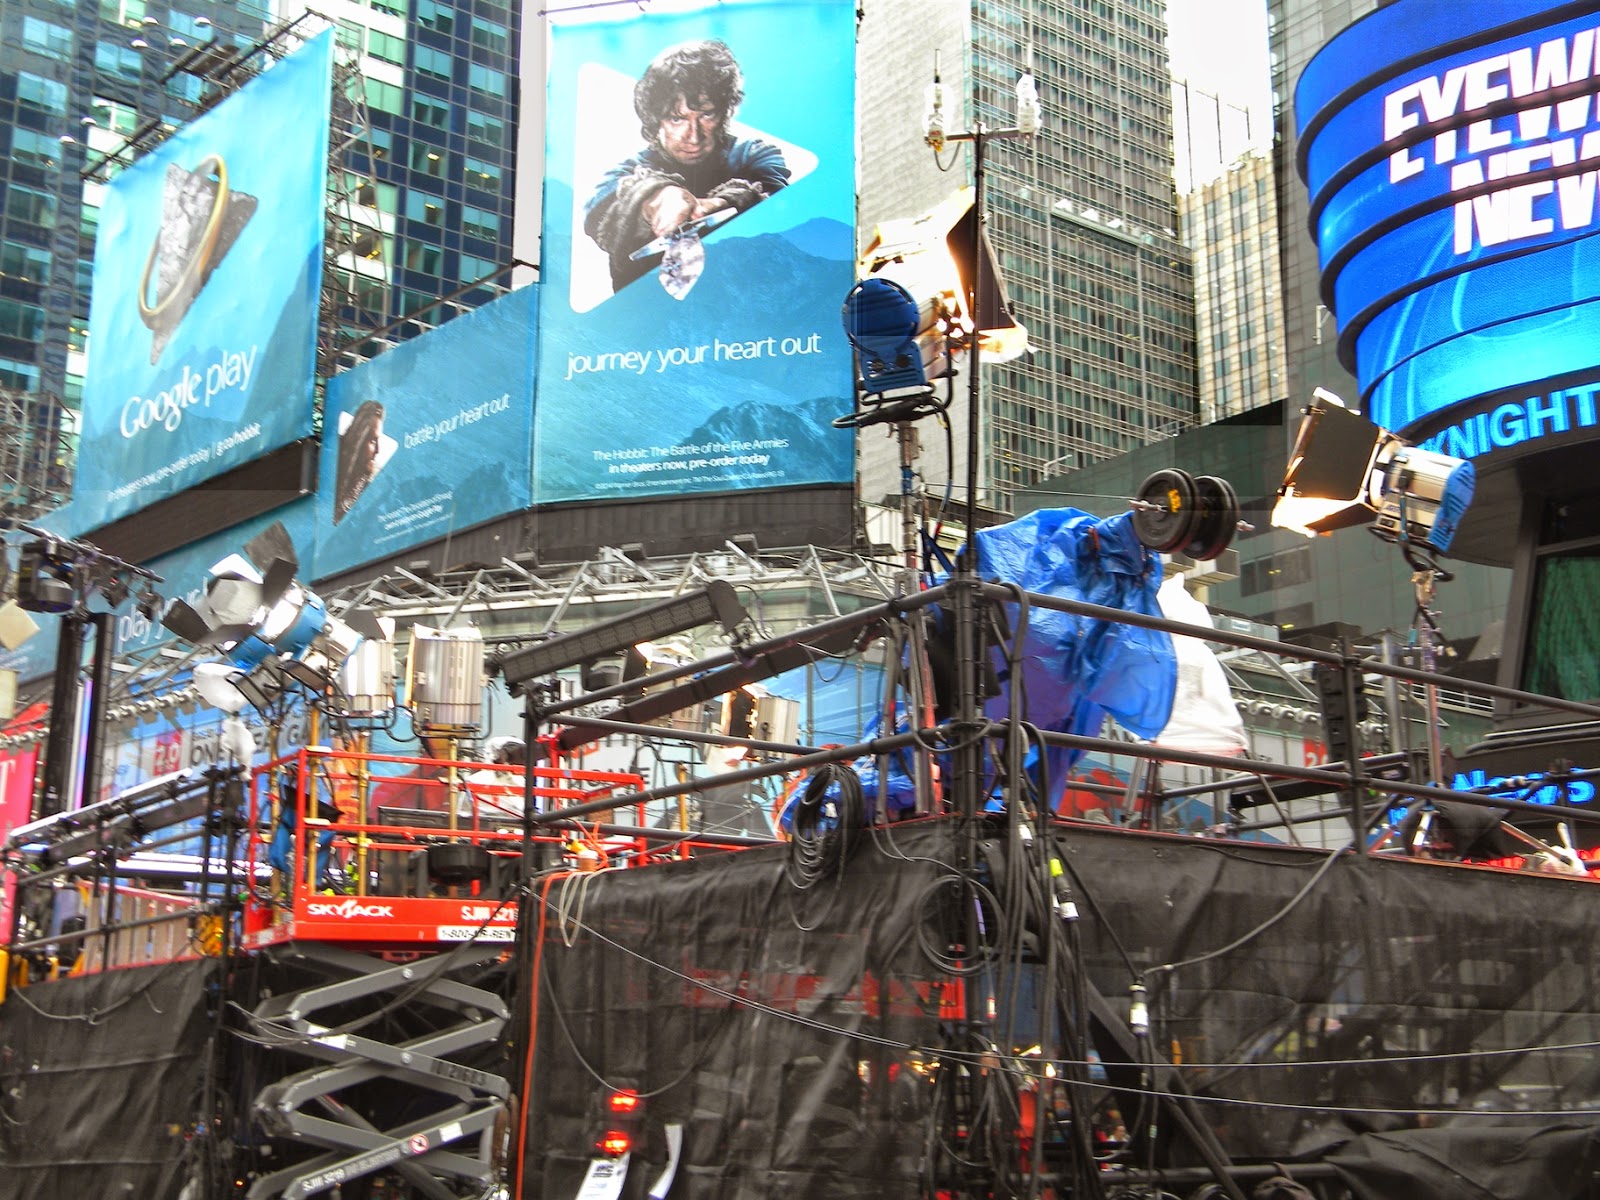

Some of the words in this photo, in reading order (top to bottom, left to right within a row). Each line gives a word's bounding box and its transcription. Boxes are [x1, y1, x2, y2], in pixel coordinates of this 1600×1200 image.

[564, 349, 652, 381] journey
[656, 344, 709, 374] your
[713, 336, 777, 362] heart
[781, 332, 822, 357] out
[120, 365, 202, 439] Google
[204, 344, 257, 407] play
[434, 414, 460, 443] your
[459, 408, 490, 427] heart
[489, 393, 510, 414] out
[592, 450, 612, 461] The
[649, 446, 669, 457] The
[669, 443, 700, 456] Battle
[700, 442, 712, 454] of
[712, 441, 731, 453] the
[752, 437, 789, 449] Armies
[608, 463, 619, 474] in
[619, 462, 662, 474] theaters
[688, 455, 738, 471] pre-order
[738, 452, 771, 466] today
[307, 899, 395, 919] SKYJACK
